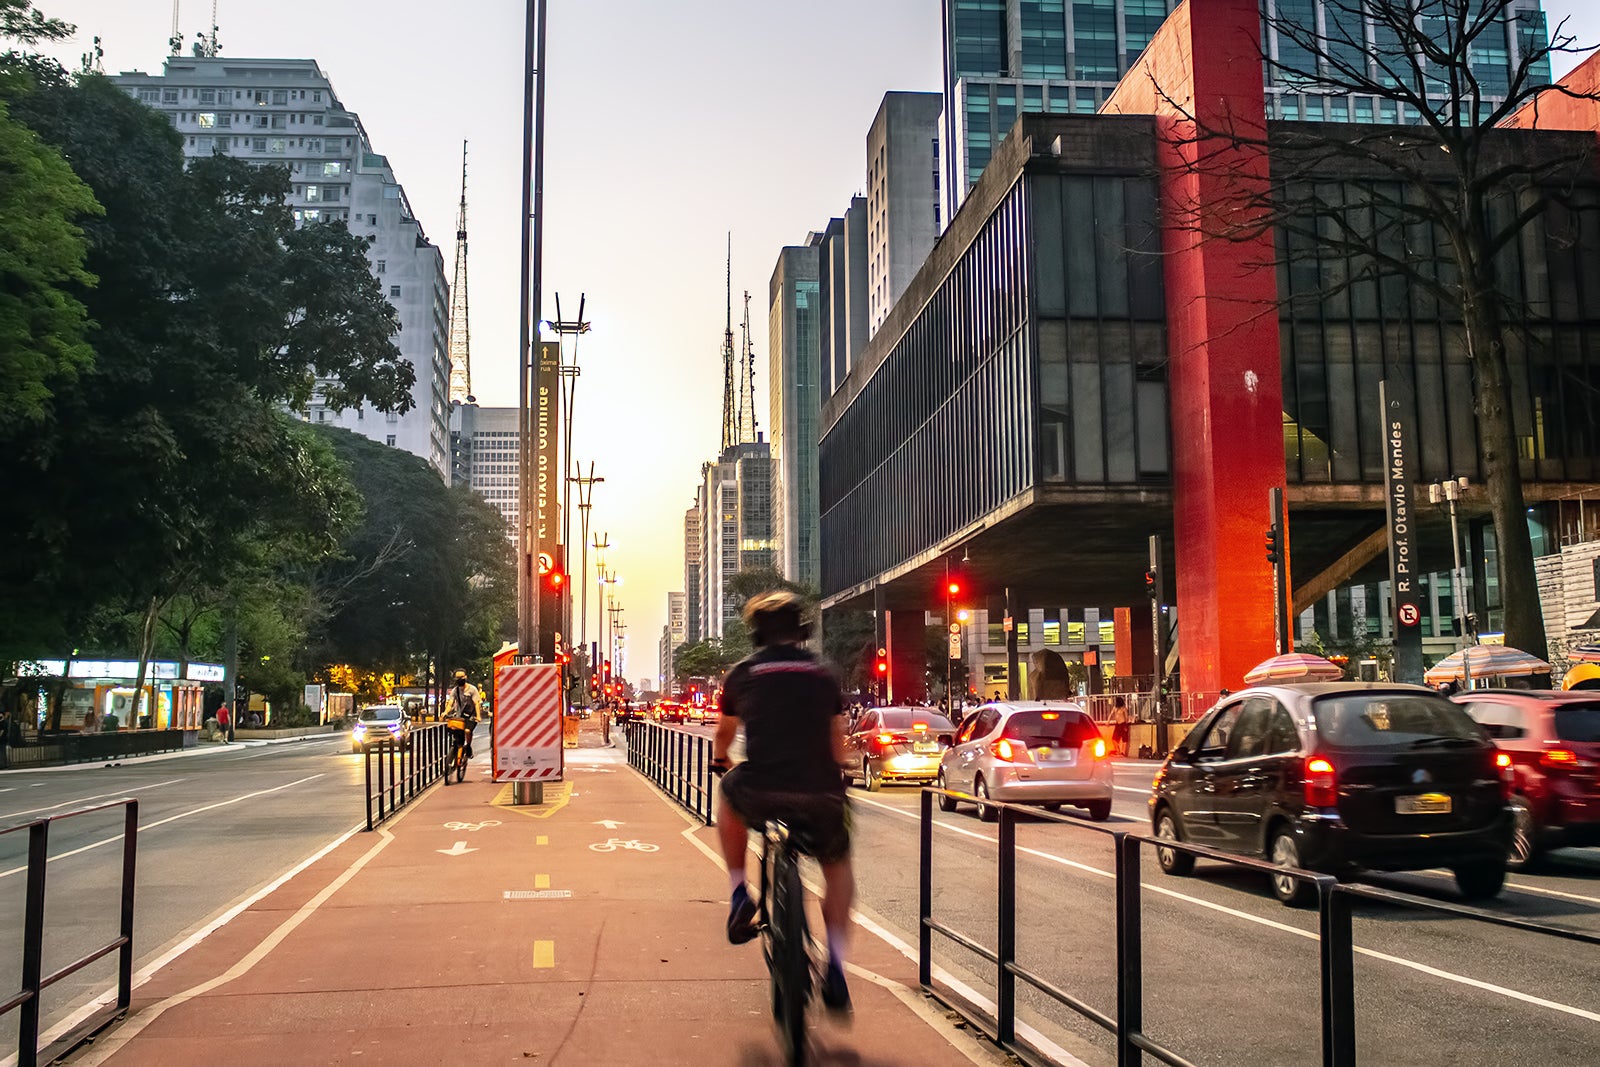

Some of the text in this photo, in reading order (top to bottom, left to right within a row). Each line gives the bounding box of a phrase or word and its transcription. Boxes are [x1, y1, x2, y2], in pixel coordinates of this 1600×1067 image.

[1390, 421, 1404, 480] Mendes
[1396, 538, 1409, 574] Prof.
[1398, 578, 1410, 592] R.
